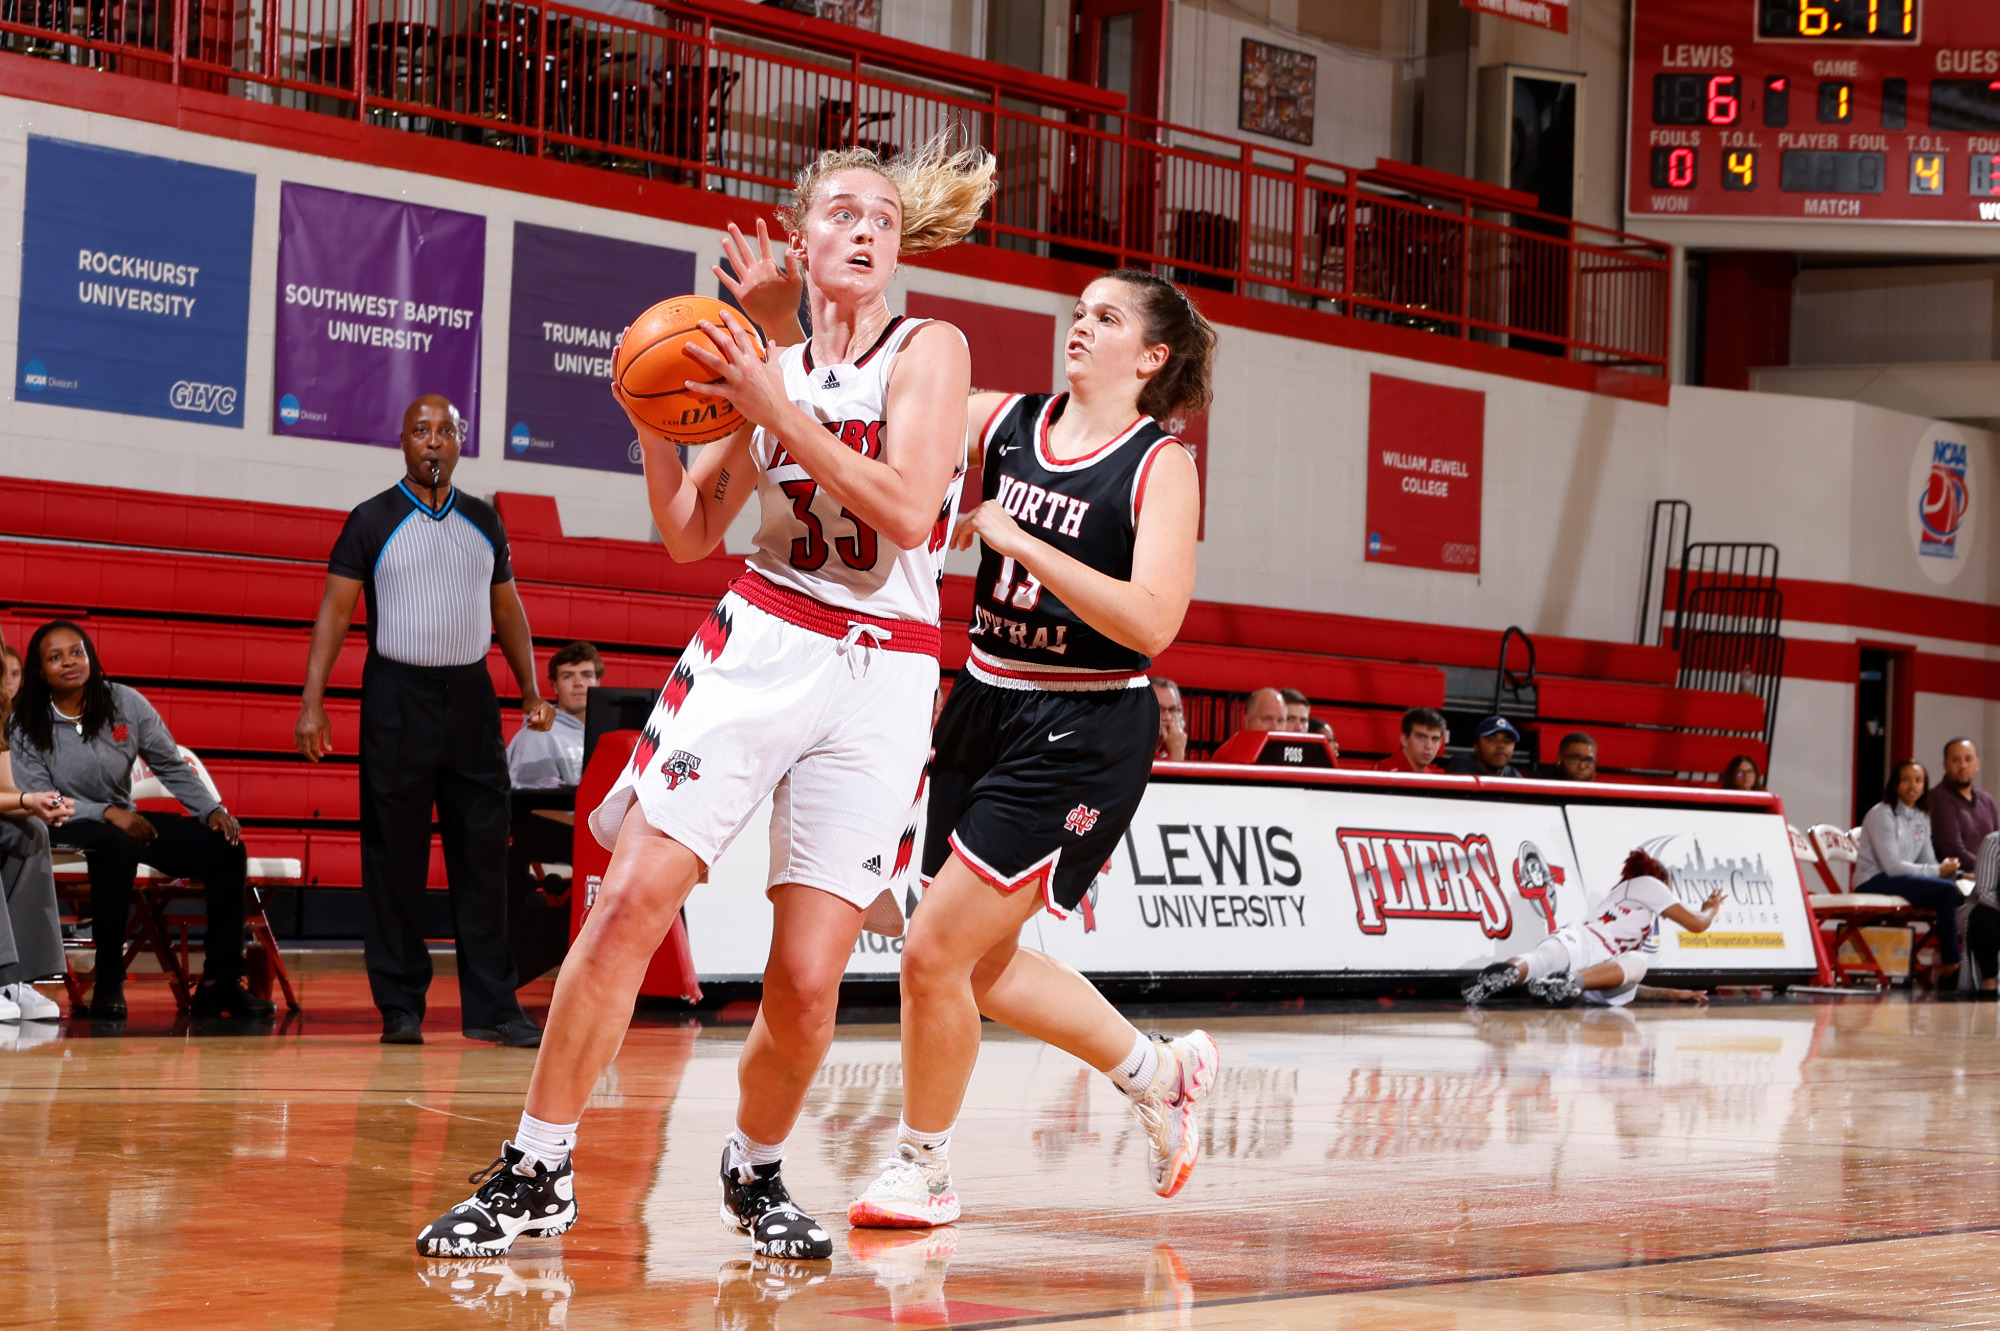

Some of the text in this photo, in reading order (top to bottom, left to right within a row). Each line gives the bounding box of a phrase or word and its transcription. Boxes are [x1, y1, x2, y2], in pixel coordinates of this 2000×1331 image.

[1662, 45, 1735, 69] LEWIS
[1813, 60, 1858, 78] GAME
[1936, 48, 2000, 74] GUES
[1706, 75, 1739, 125] 6
[1837, 86, 1850, 121] 1
[1650, 130, 1701, 147] FOULS
[1720, 131, 1763, 149] T.O.L.
[1778, 133, 1889, 151] PLAYER FOUL
[1906, 135, 1951, 152] T.O.L.
[1667, 147, 1695, 188] 0
[1727, 151, 1754, 187] 4
[1914, 156, 1941, 191] 4
[1651, 196, 1690, 212] WON
[1804, 199, 1861, 217] MATCH
[79, 249, 199, 288] ROCKHURST
[78, 281, 196, 318] UNIVERSITY
[285, 283, 474, 330] SOUTHWEST BAPTIST
[327, 319, 433, 353] UNIVERSITY
[543, 321, 611, 351] TRUMAN
[25, 373, 47, 386] NCAA
[554, 352, 613, 379] UNIVER
[48, 376, 73, 389] Division
[821, 381, 841, 389] adidas
[170, 380, 237, 415] GLVC
[280, 407, 300, 419] NCAA
[301, 409, 322, 421] Division
[1170, 418, 1186, 434] OF
[1382, 450, 1470, 479] WILLIAM JEWELL
[1932, 439, 1967, 467] NCAA
[713, 467, 731, 504] XXXIII
[1401, 476, 1449, 498] COLLEGE
[996, 473, 1091, 540] NORTH
[779, 479, 878, 572] 33
[1283, 746, 1304, 763] POSS
[1124, 822, 1303, 888] LEWIS
[1336, 827, 1513, 940] FLYERS
[1730, 868, 1775, 906] CITY
[1137, 894, 1306, 929] UNIVERSITY
[1679, 934, 1784, 949] Providing Transportation Worldwide
